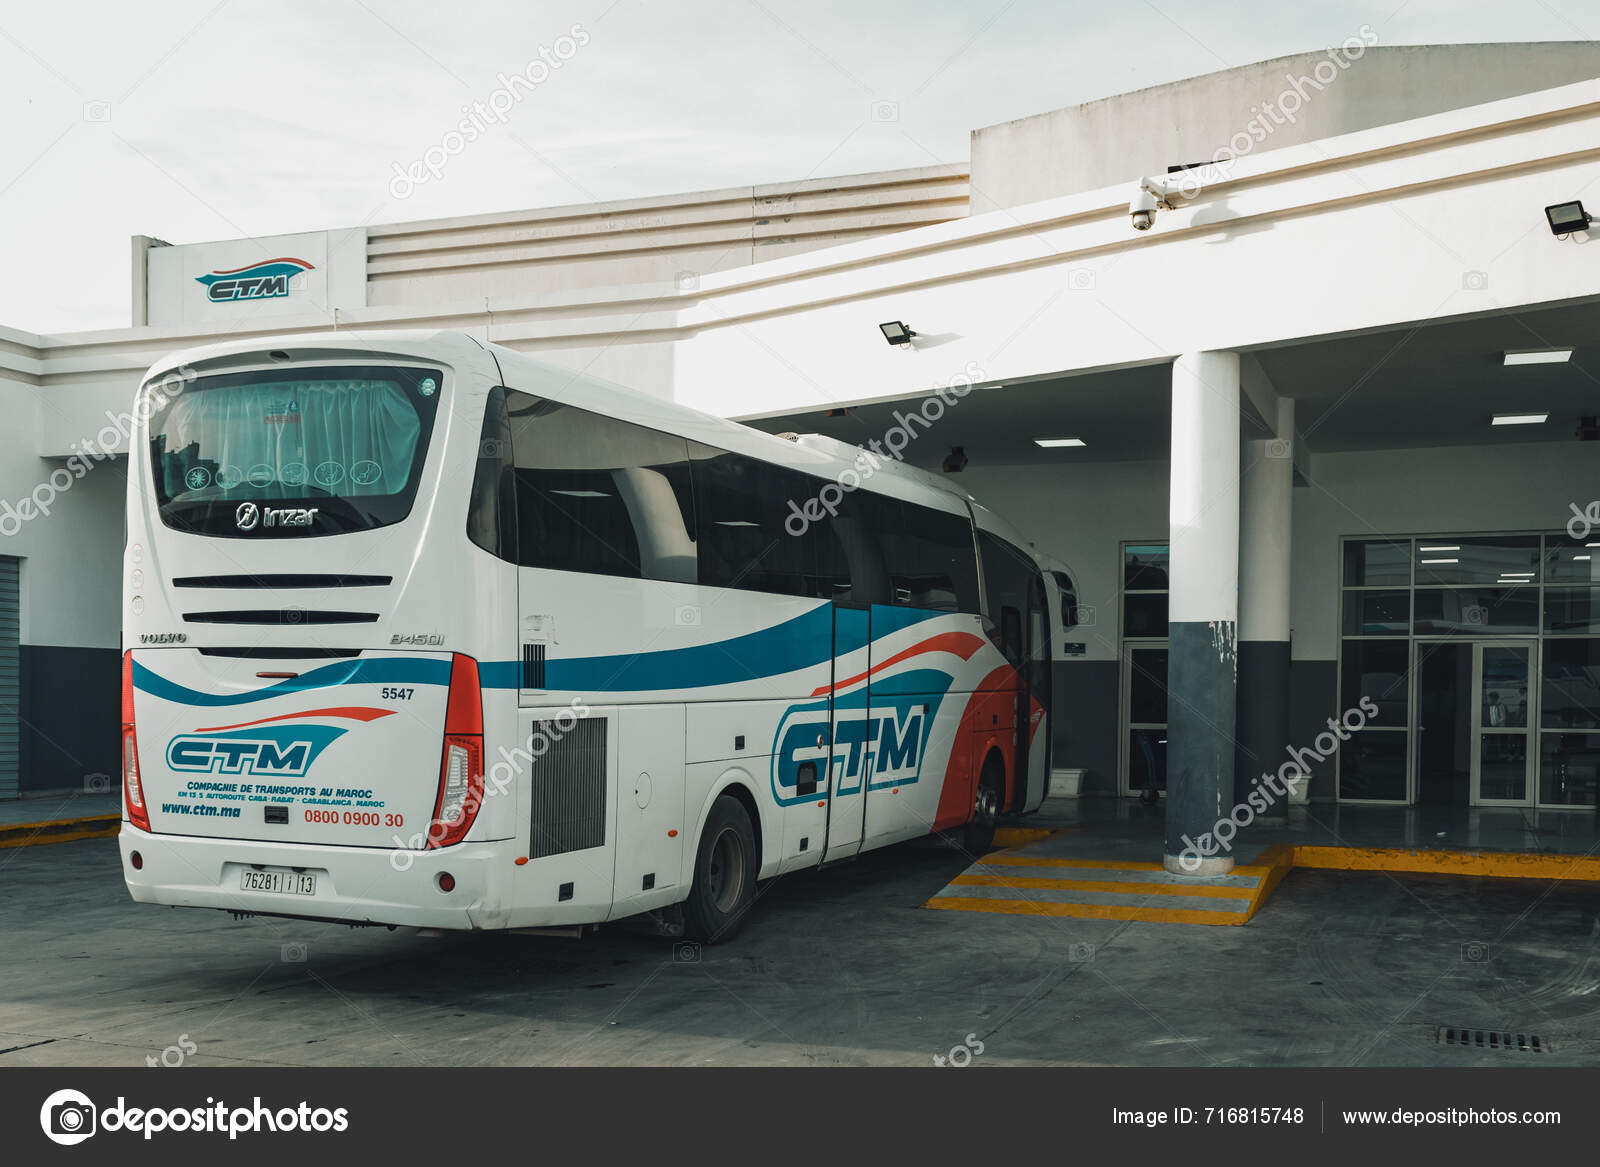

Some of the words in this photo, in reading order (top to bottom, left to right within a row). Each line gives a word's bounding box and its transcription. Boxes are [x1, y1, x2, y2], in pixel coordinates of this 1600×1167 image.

[209, 276, 286, 299] CTM
[138, 632, 188, 644] VOLVO
[381, 687, 415, 700] 5547
[170, 740, 308, 770] CTM
[778, 715, 923, 788] CTM
[187, 781, 238, 793] COMPAGNIE
[240, 783, 253, 793] DE
[255, 784, 316, 797] TRANSPORTS
[319, 787, 333, 797] AU
[336, 788, 373, 799] MAROC
[206, 793, 246, 801] AUTOROUTE
[356, 800, 385, 808] MAROC
[161, 803, 241, 818] www.ctm.ma
[304, 809, 339, 824] 0800
[343, 811, 380, 826] 0900
[384, 813, 404, 828] 30
[245, 872, 277, 891] 76281
[301, 876, 313, 893] 13
